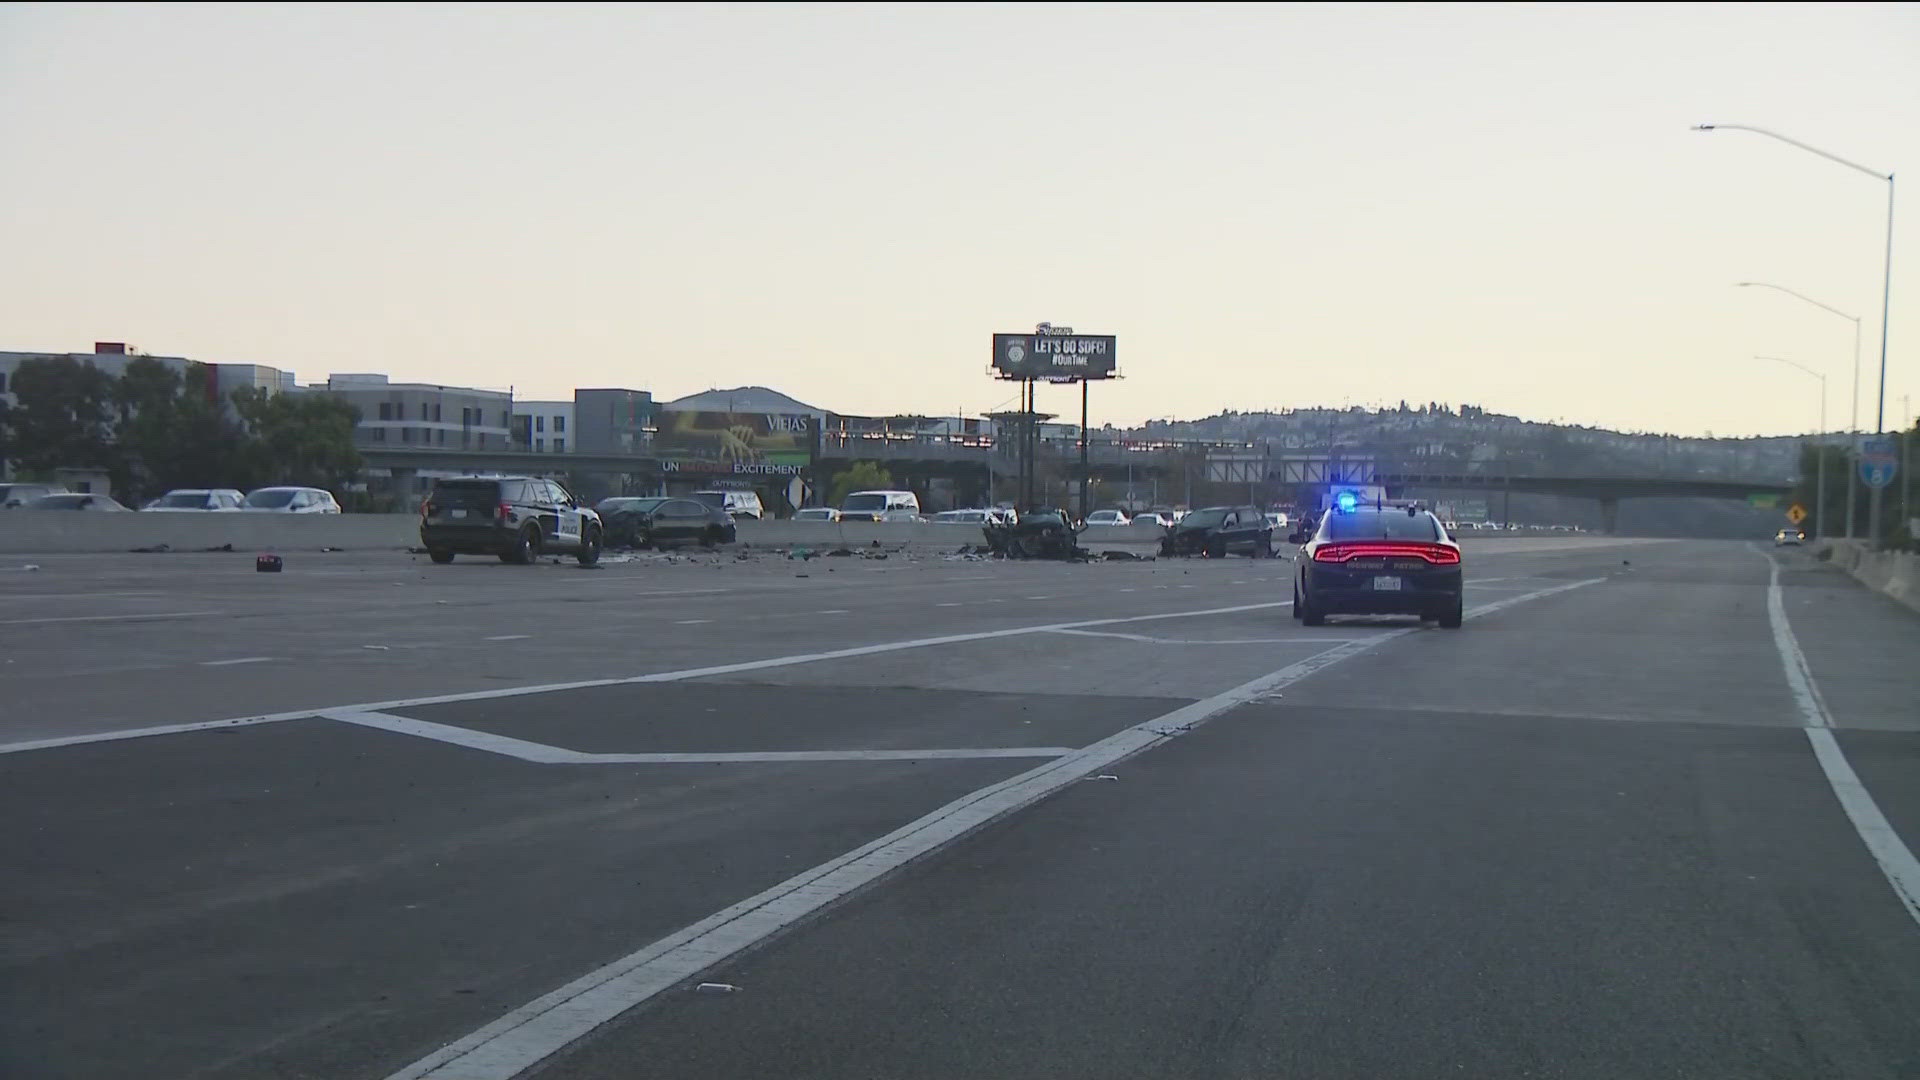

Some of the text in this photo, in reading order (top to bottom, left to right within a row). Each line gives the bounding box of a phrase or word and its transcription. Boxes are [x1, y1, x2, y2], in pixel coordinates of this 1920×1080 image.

[1035, 339, 1061, 353] LET'S
[1063, 340, 1076, 354] GO
[767, 415, 807, 431] VIEJAS
[734, 464, 803, 475] EXCITEMENT
